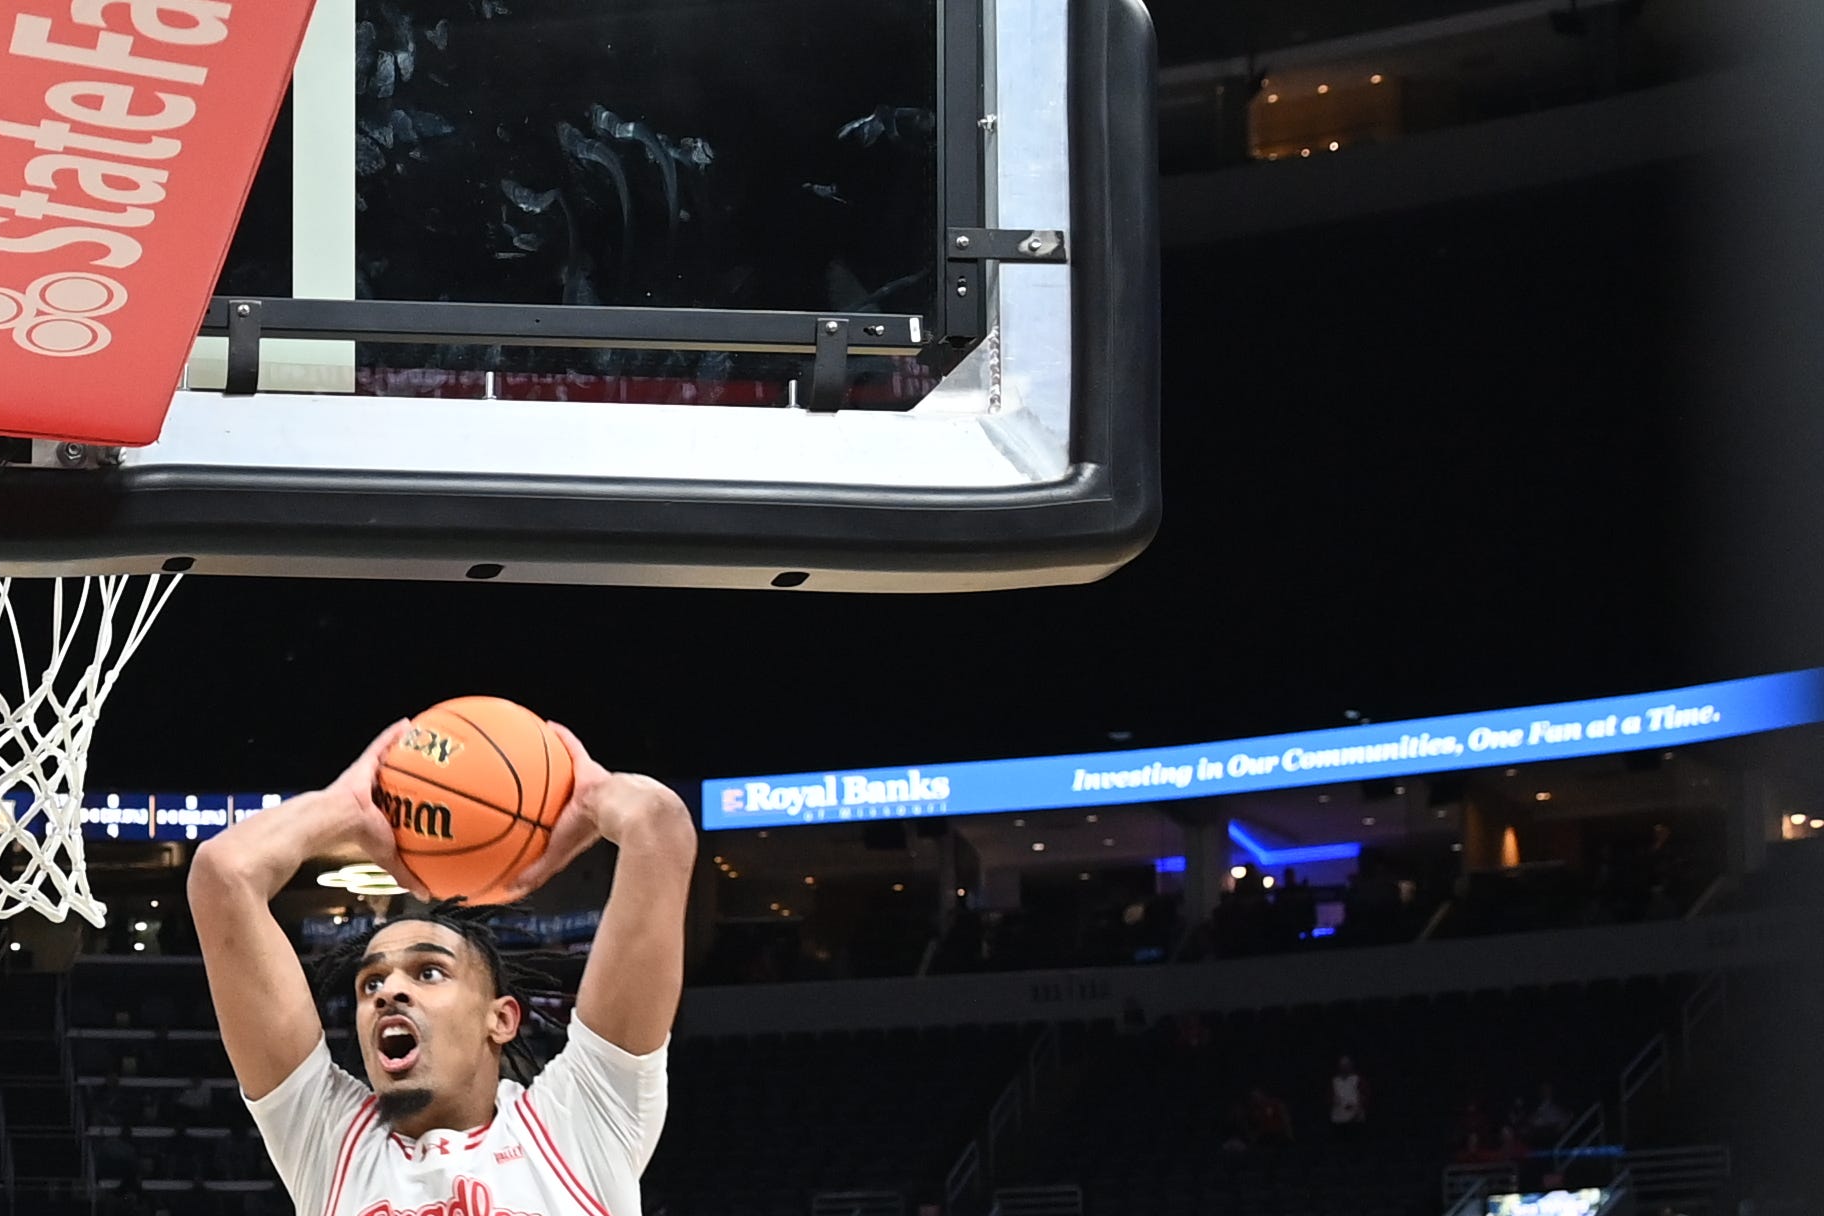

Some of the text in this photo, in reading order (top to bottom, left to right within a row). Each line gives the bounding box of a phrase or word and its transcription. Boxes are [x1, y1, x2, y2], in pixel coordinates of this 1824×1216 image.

[1071, 703, 1722, 792] Investing in Our Communities, One Fan at a Time.
[744, 769, 951, 816] Royal Banks
